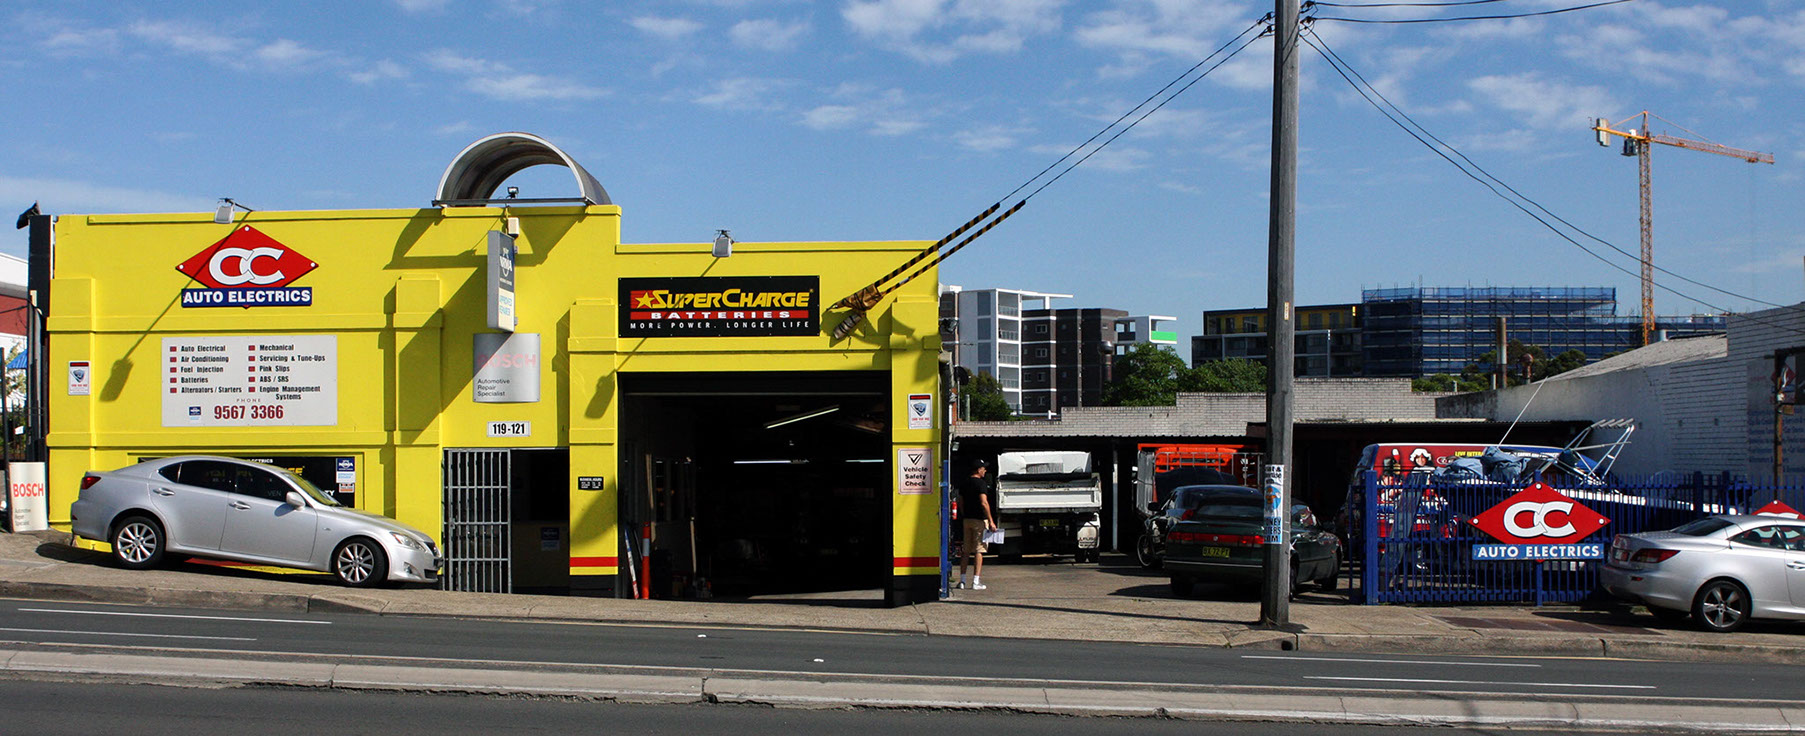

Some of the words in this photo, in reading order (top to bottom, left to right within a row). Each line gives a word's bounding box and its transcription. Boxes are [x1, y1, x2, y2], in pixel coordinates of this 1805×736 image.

[209, 247, 285, 285] CC
[183, 291, 224, 303] AUTO
[228, 290, 311, 302] ELECTRICS
[651, 311, 791, 319] BATTERIES
[477, 353, 537, 368] BOSCH
[214, 405, 246, 419] 9567
[251, 405, 284, 419] 3366
[493, 423, 525, 434] 119-121
[13, 483, 44, 497] BOSCH
[1503, 501, 1577, 537] CC
[1478, 546, 1519, 557] AUTO
[1525, 545, 1600, 557] ELECTRICS
